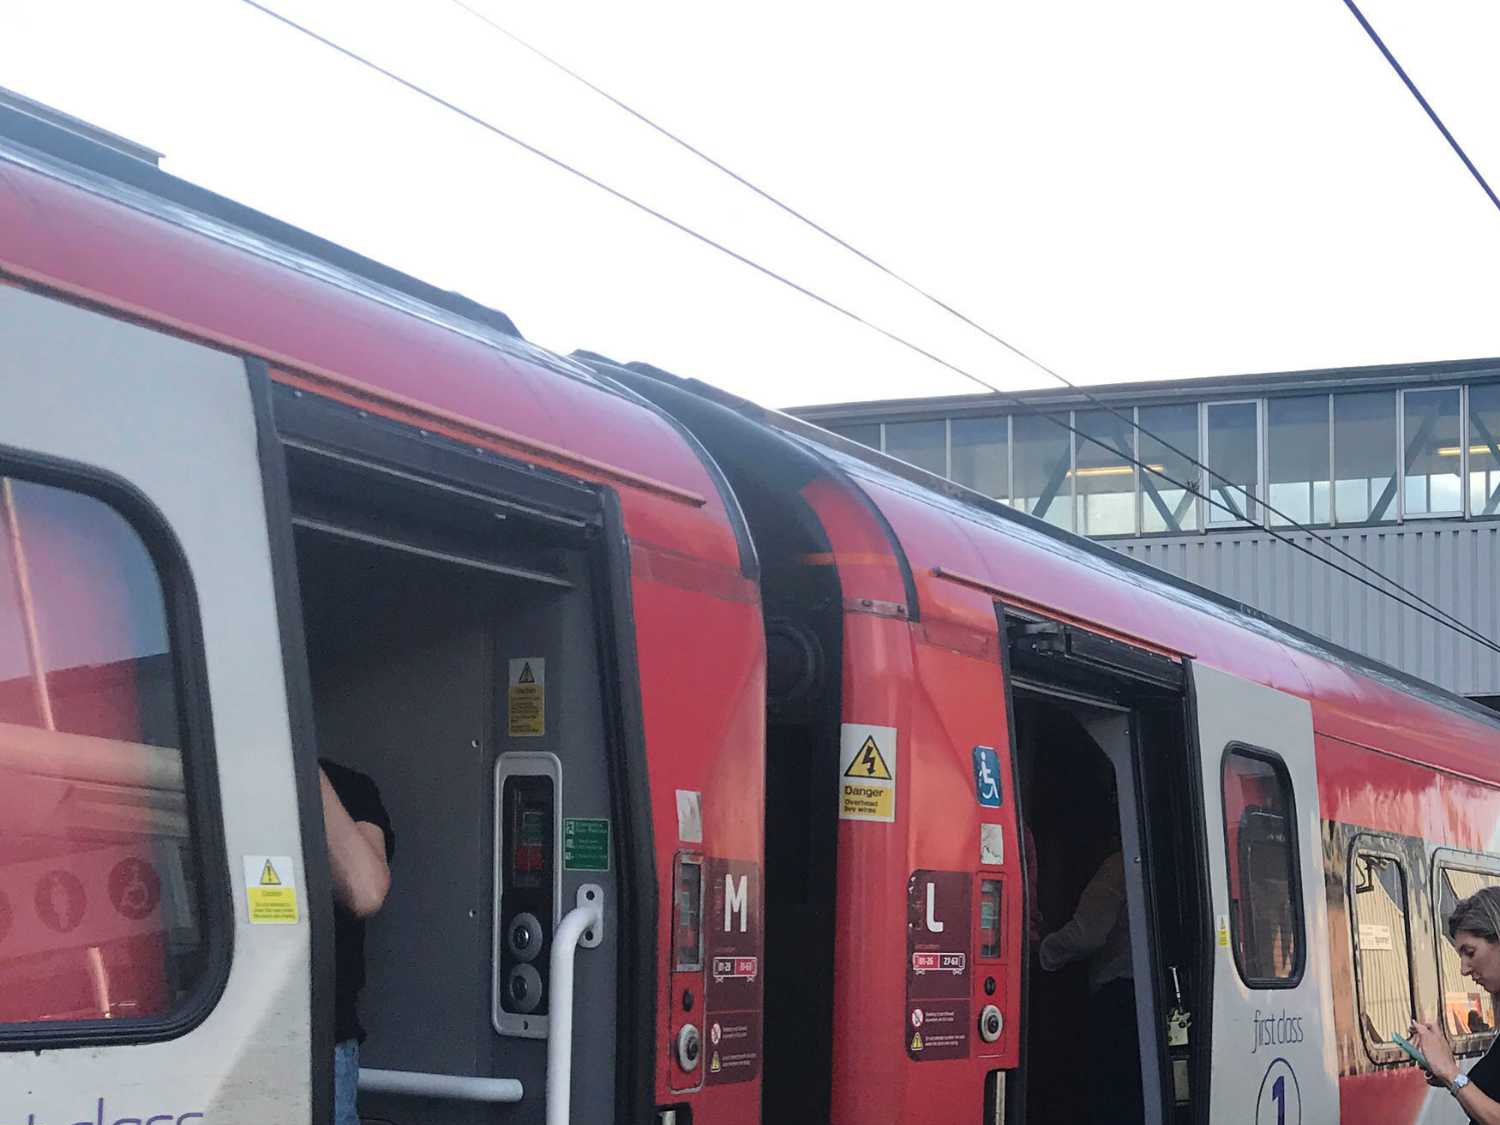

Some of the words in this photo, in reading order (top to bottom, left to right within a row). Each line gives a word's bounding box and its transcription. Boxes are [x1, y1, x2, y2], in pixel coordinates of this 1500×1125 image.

[844, 785, 884, 798] Danger
[844, 799, 879, 807] Overhead
[724, 873, 747, 933] M
[926, 882, 944, 933] L
[1250, 1009, 1277, 1054] first
[1277, 1008, 1304, 1045] class
